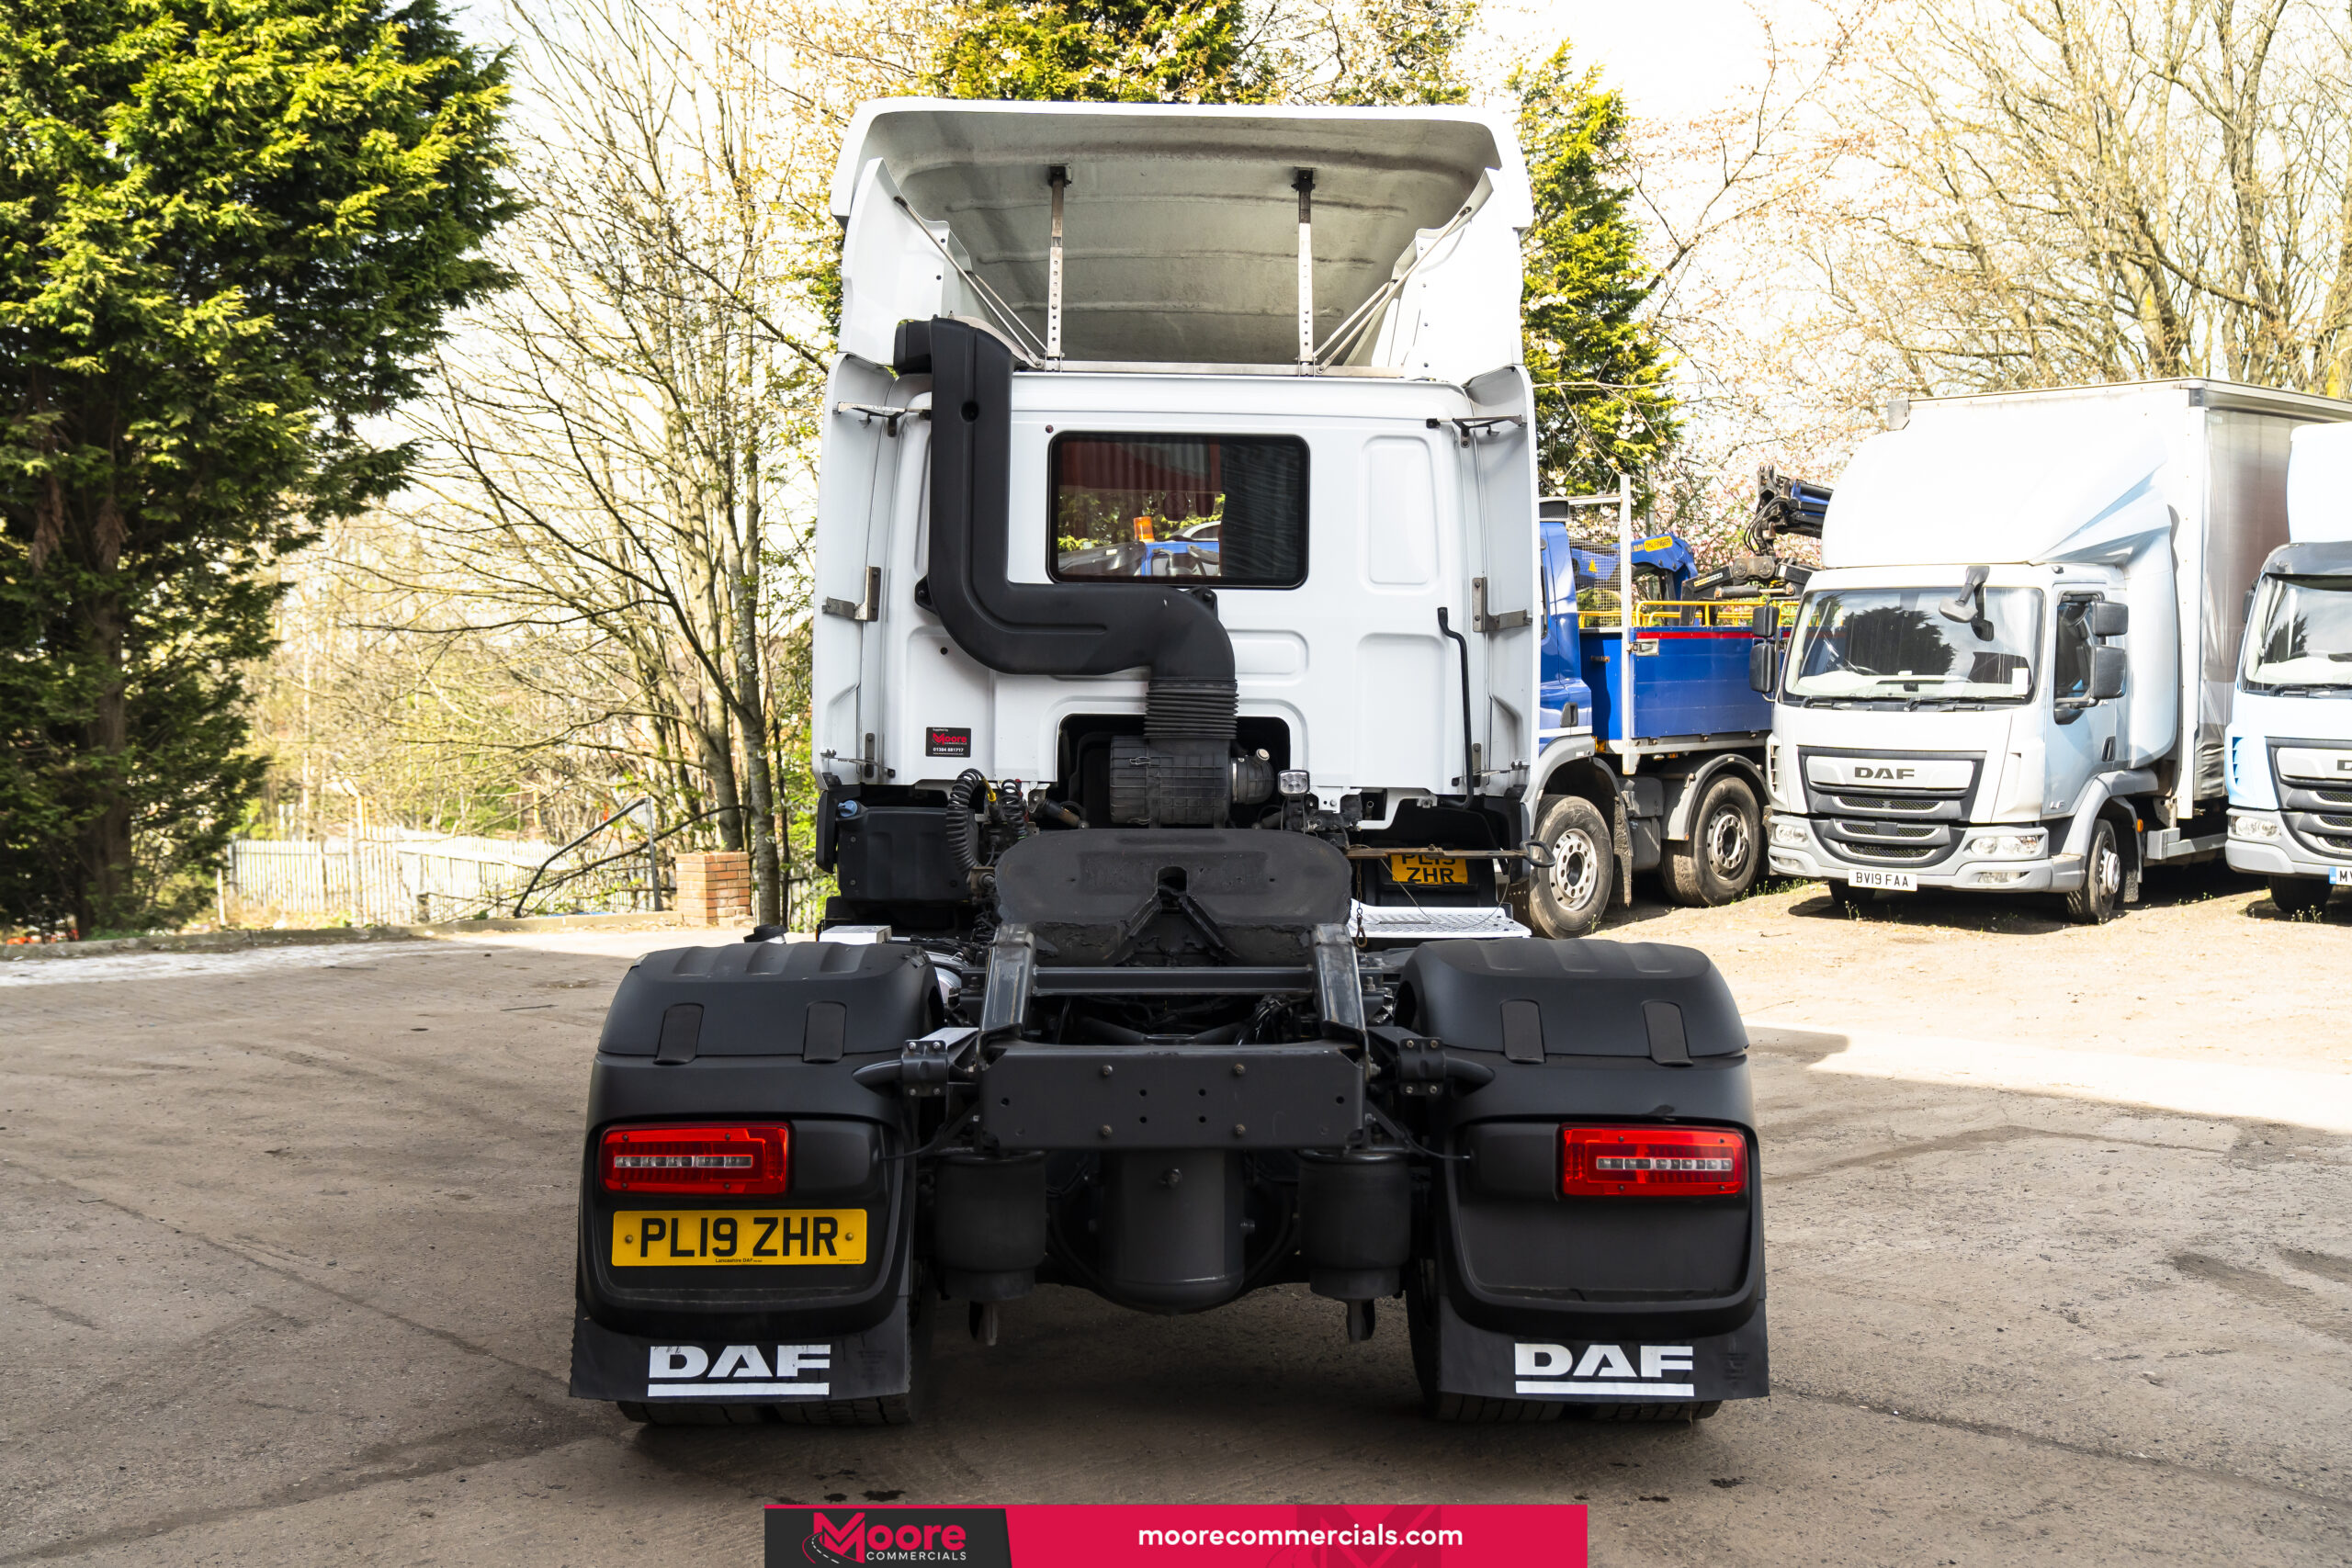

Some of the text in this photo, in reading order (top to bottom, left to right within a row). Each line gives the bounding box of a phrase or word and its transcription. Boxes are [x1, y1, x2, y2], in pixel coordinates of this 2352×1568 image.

[933, 733, 967, 745] Moore
[1855, 766, 1915, 780] DAF
[1406, 867, 1454, 883] ZHR
[1856, 872, 1909, 887] BV19 FAA
[639, 1216, 838, 1258] PL19 ZHR
[649, 1344, 831, 1378] DAF
[1514, 1342, 1693, 1378] DAF
